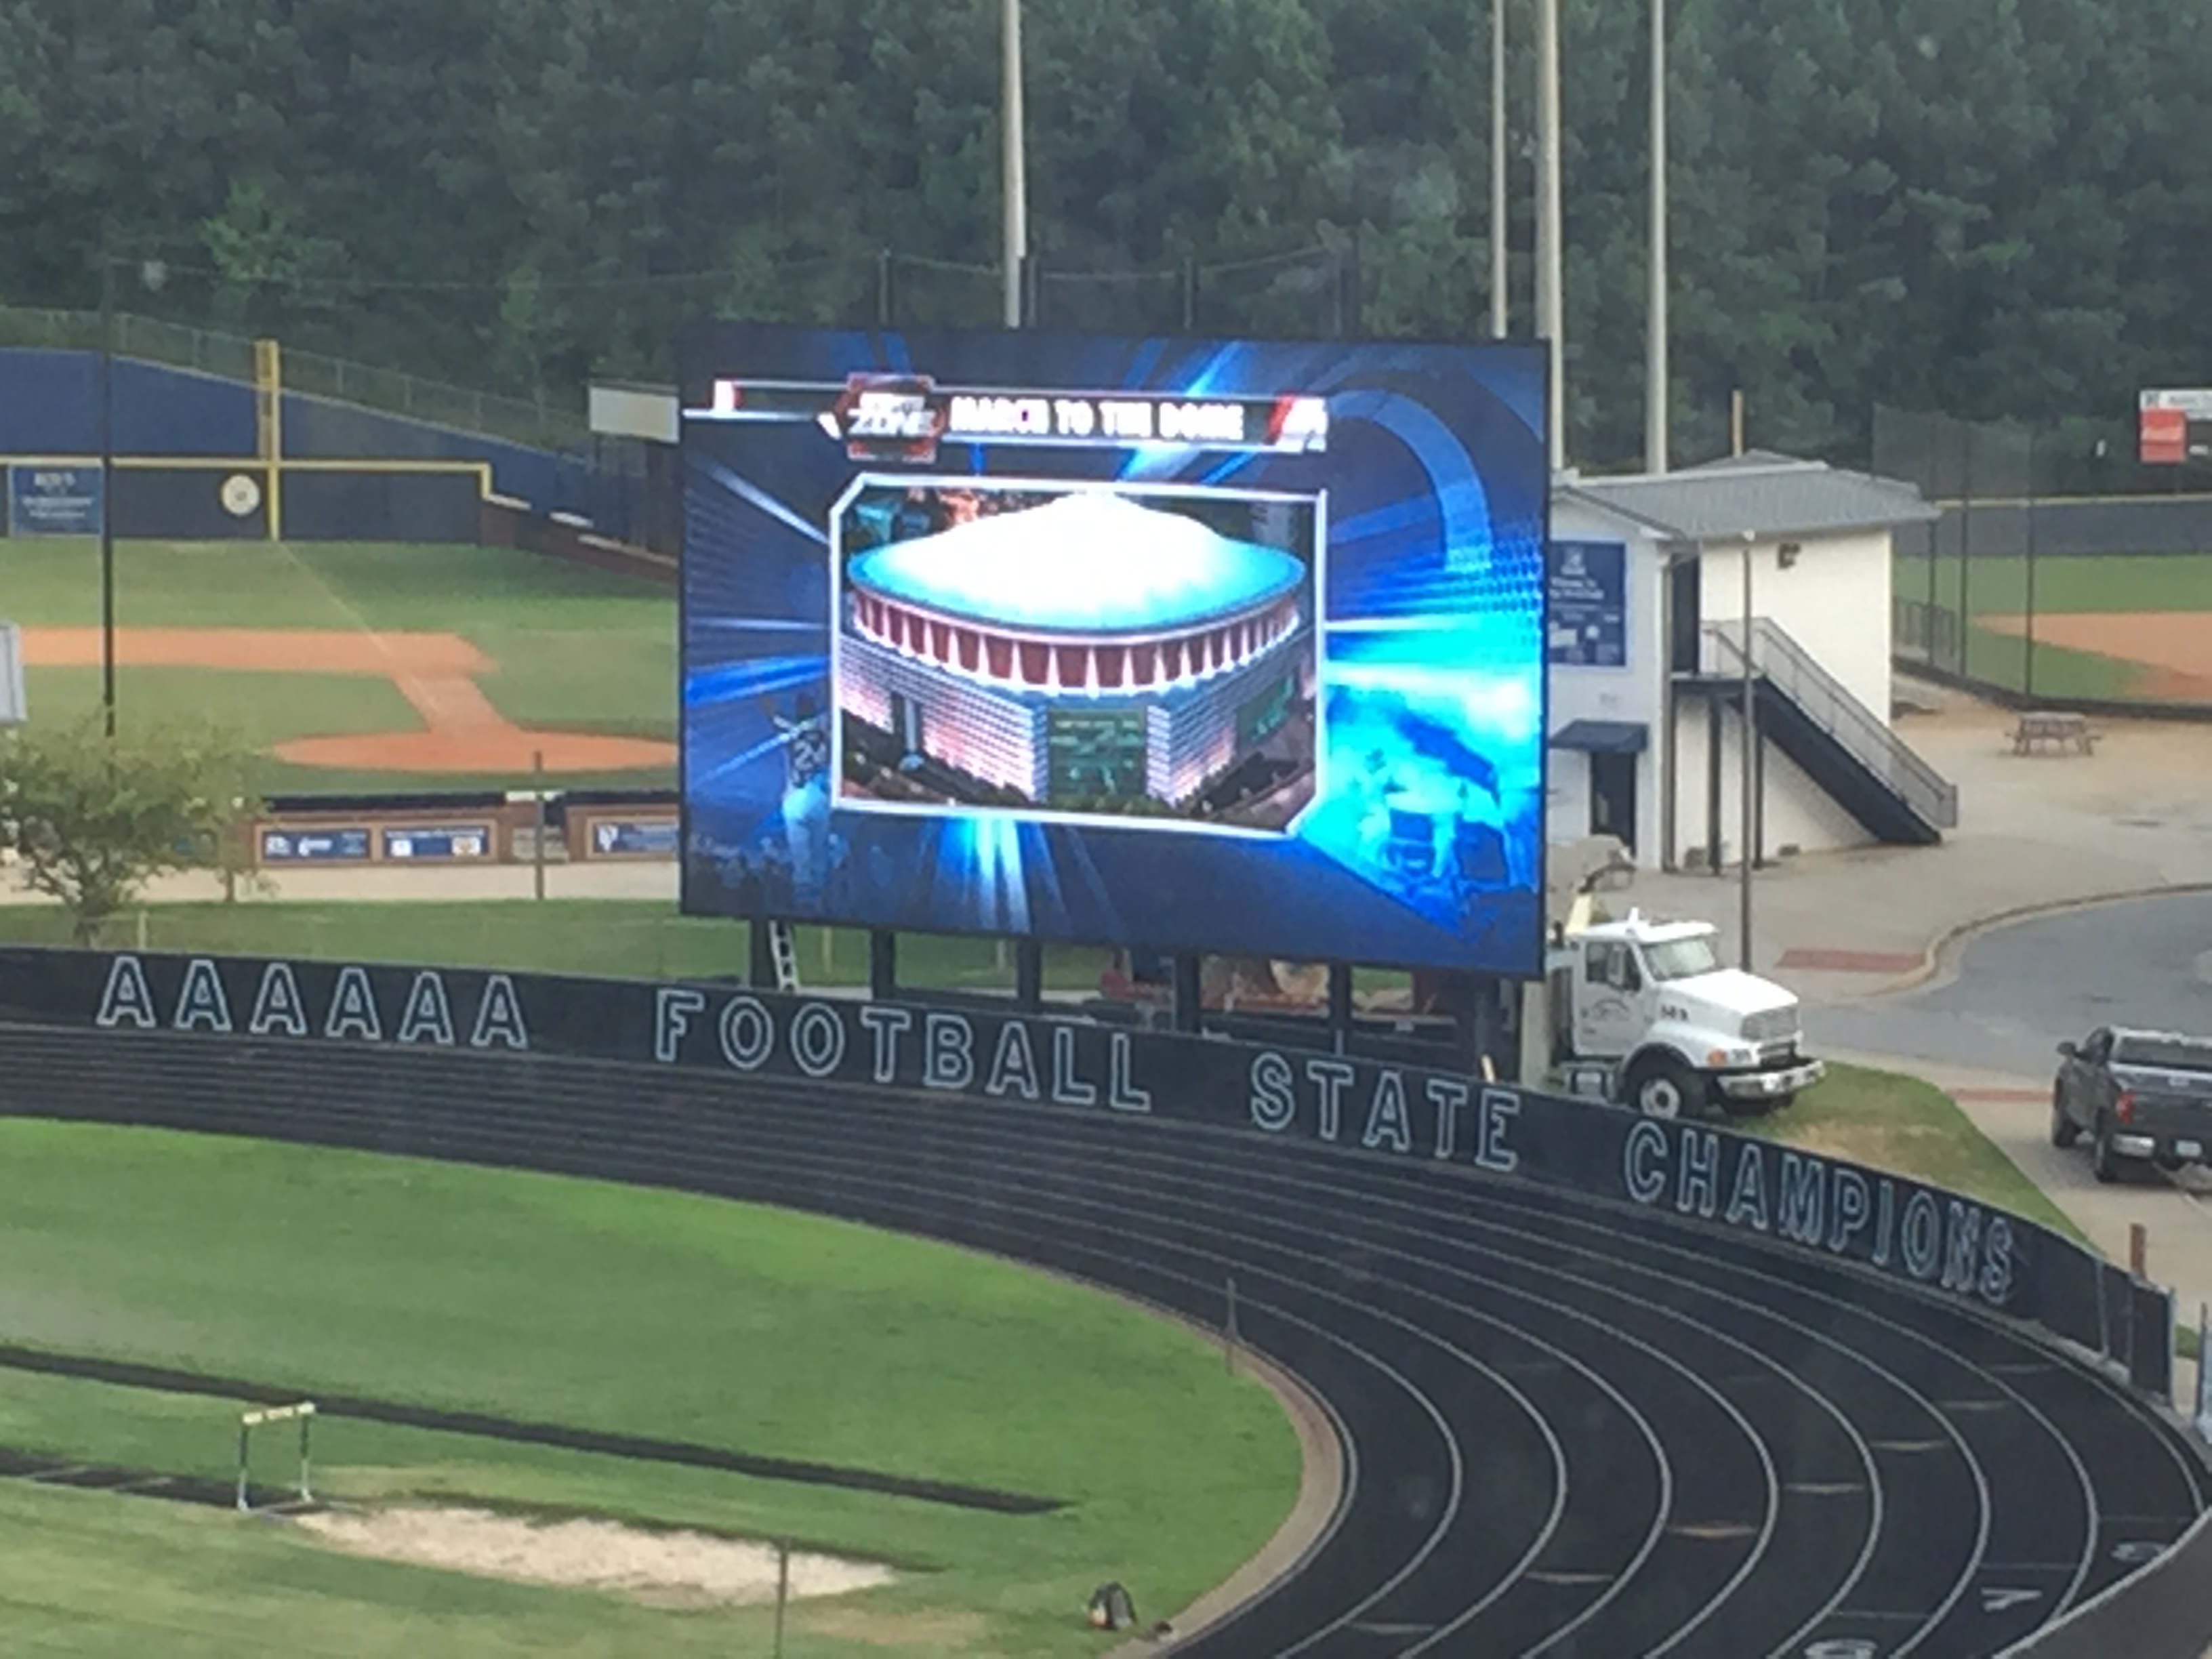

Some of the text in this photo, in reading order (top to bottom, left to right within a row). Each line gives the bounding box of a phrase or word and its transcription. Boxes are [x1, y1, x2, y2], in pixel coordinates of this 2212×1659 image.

[1054, 398, 1094, 436] TO
[655, 989, 1151, 1112] FOOTBALL
[1251, 1053, 1520, 1171] STATE
[1626, 1122, 2013, 1305] CHAMPIONS
